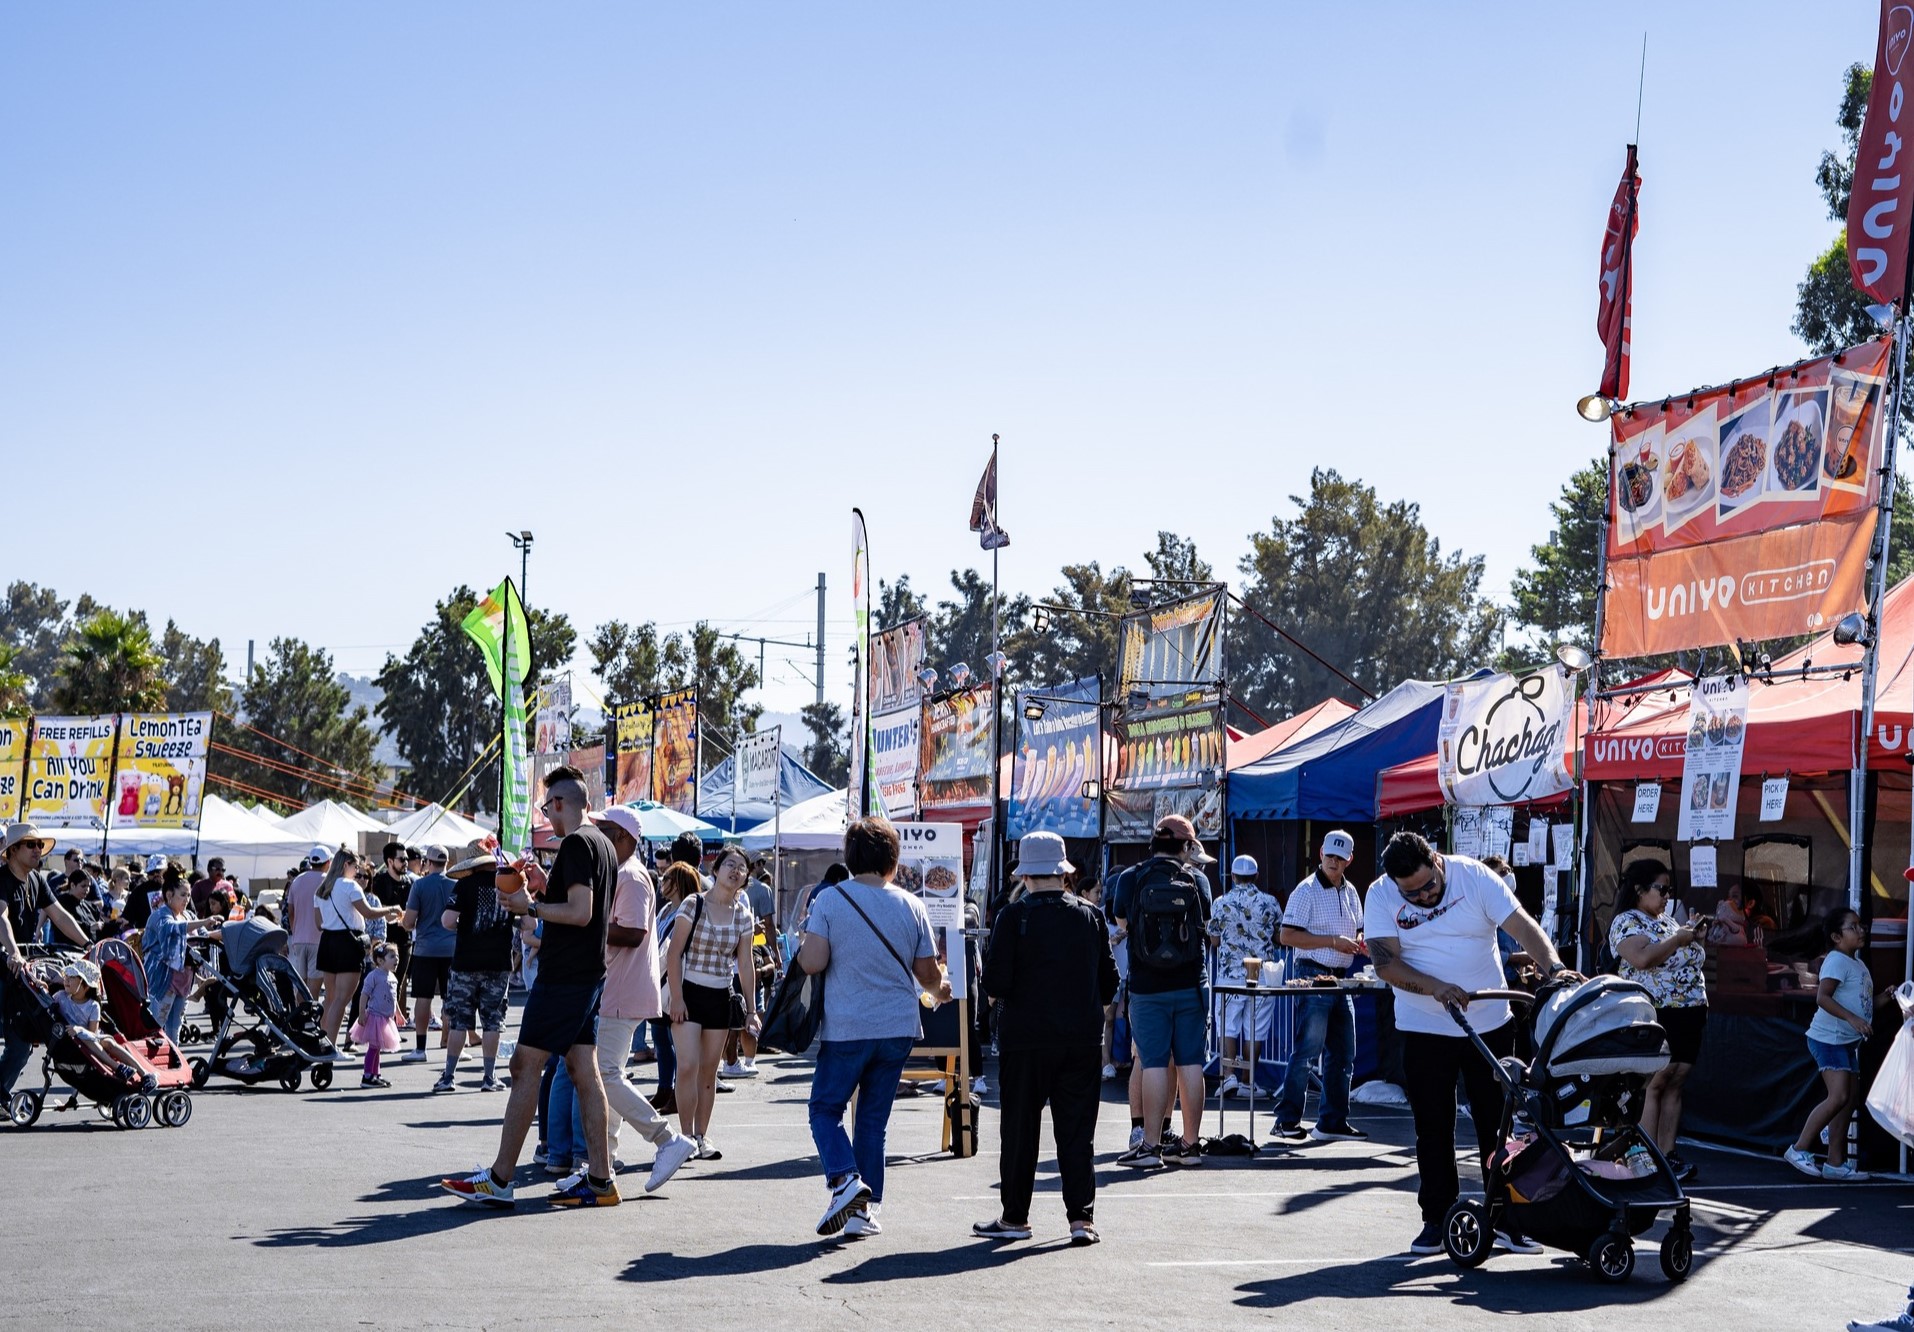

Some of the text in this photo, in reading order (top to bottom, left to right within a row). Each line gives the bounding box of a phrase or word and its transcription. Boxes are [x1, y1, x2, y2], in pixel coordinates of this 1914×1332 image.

[1857, 81, 1904, 287] UNIYO
[1647, 575, 1736, 621] UNIYO
[39, 725, 110, 740] FREE REFILLS
[130, 718, 176, 738] Lemon
[135, 740, 193, 758] Squeeze
[1457, 715, 1560, 775] Chachag
[1594, 737, 1687, 762] UNIYO KITC
[47, 755, 96, 776] All You
[33, 779, 64, 799] Can
[69, 779, 105, 799] Drink
[1637, 788, 1659, 798] ORDER
[1764, 784, 1779, 794] PICK
[1637, 804, 1655, 813] HERE
[1765, 799, 1783, 809] HERE
